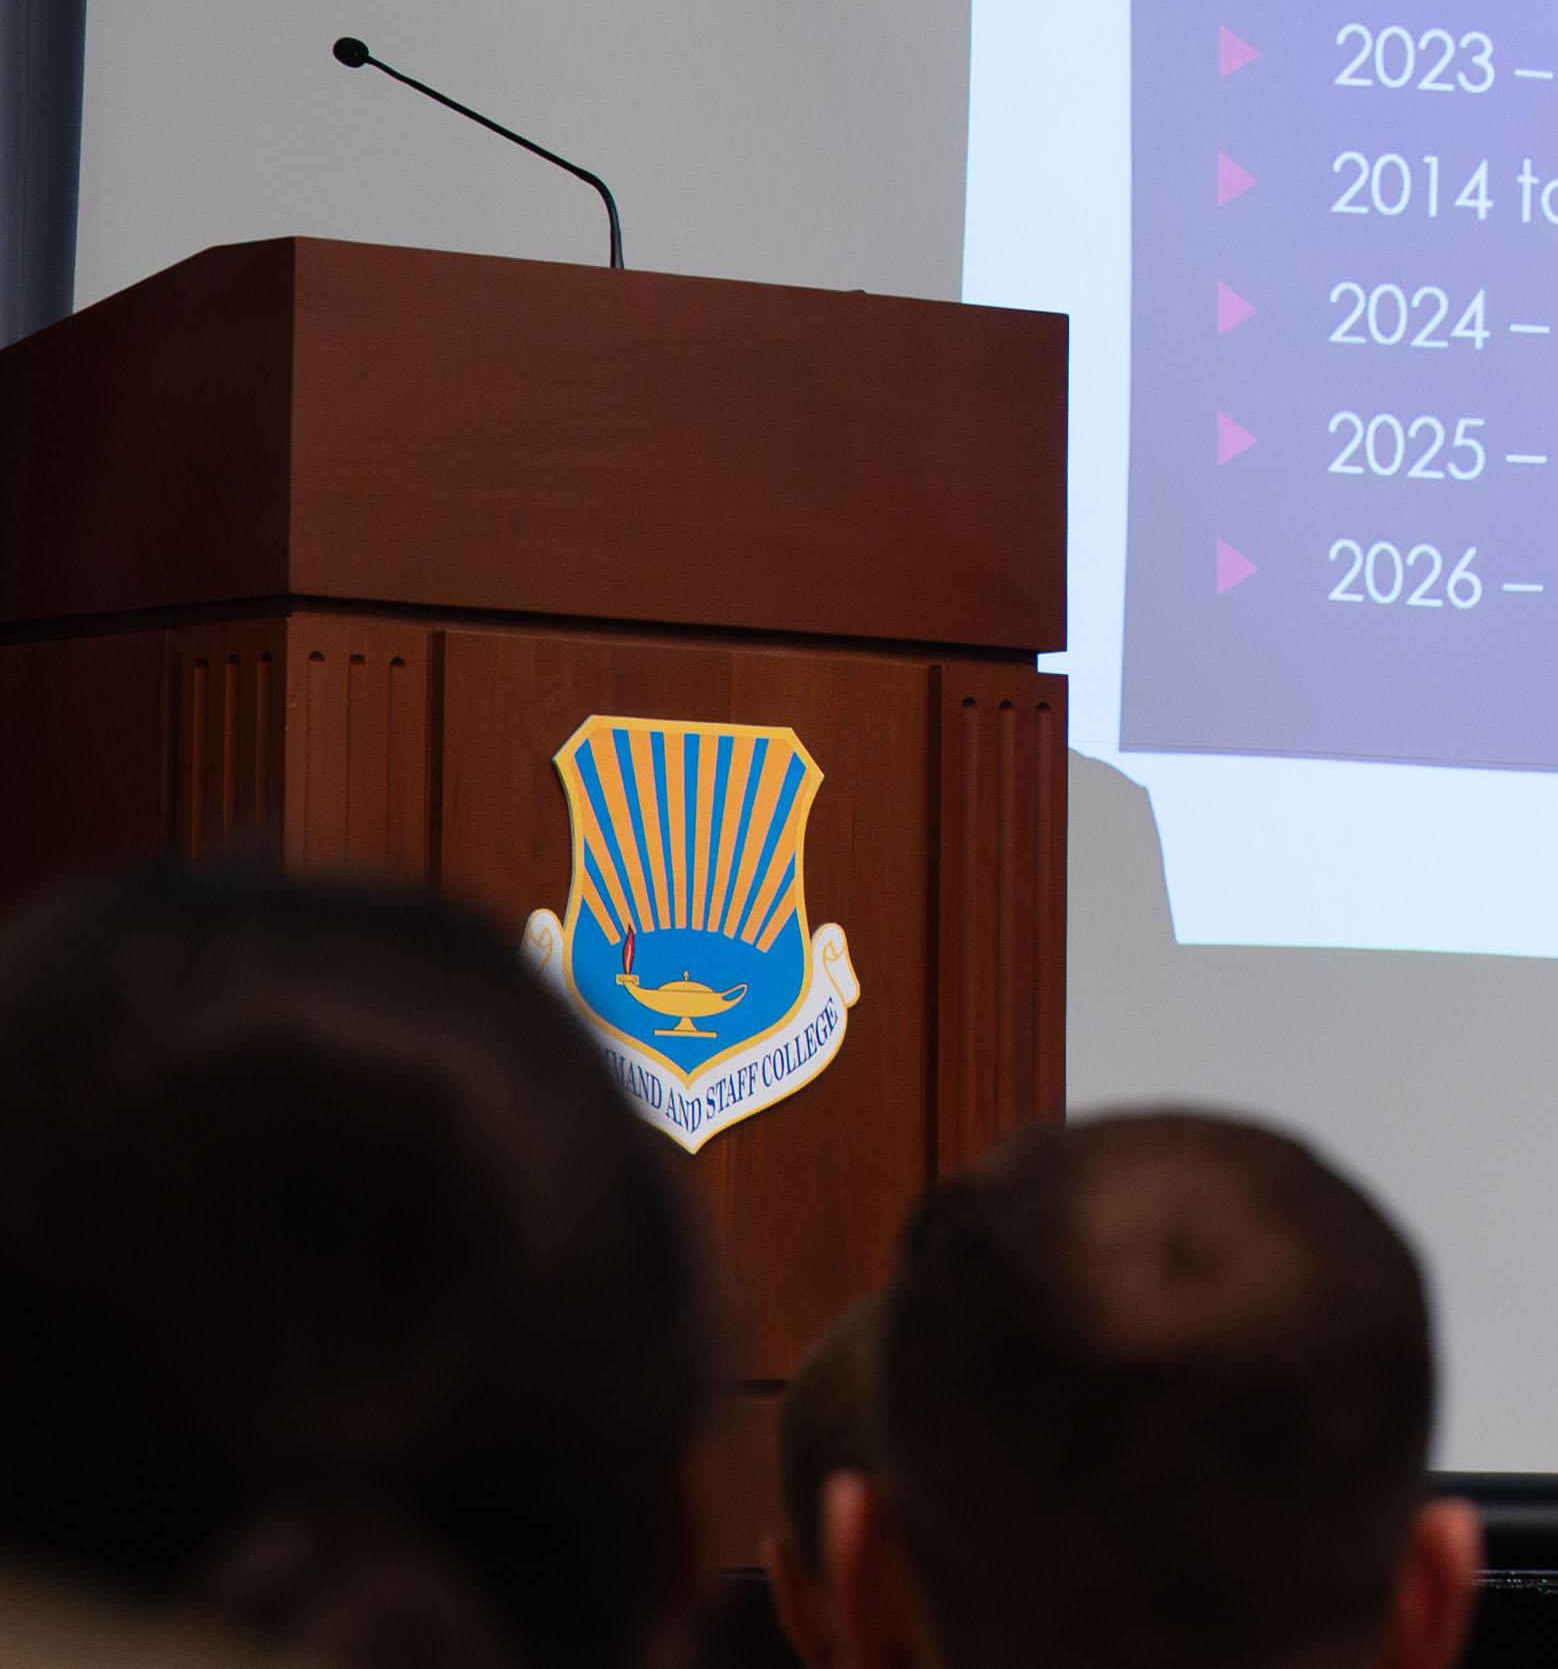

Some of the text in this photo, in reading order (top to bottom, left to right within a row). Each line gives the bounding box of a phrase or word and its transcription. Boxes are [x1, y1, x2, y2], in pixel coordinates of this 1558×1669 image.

[1333, 23, 1496, 94] 2023
[1330, 150, 1494, 221] 2014
[1327, 281, 1491, 351] 2024
[1327, 410, 1486, 481] 2025
[1327, 538, 1483, 610] 2026
[604, 996, 839, 1134] MAND AND STAFF COLLEGE
